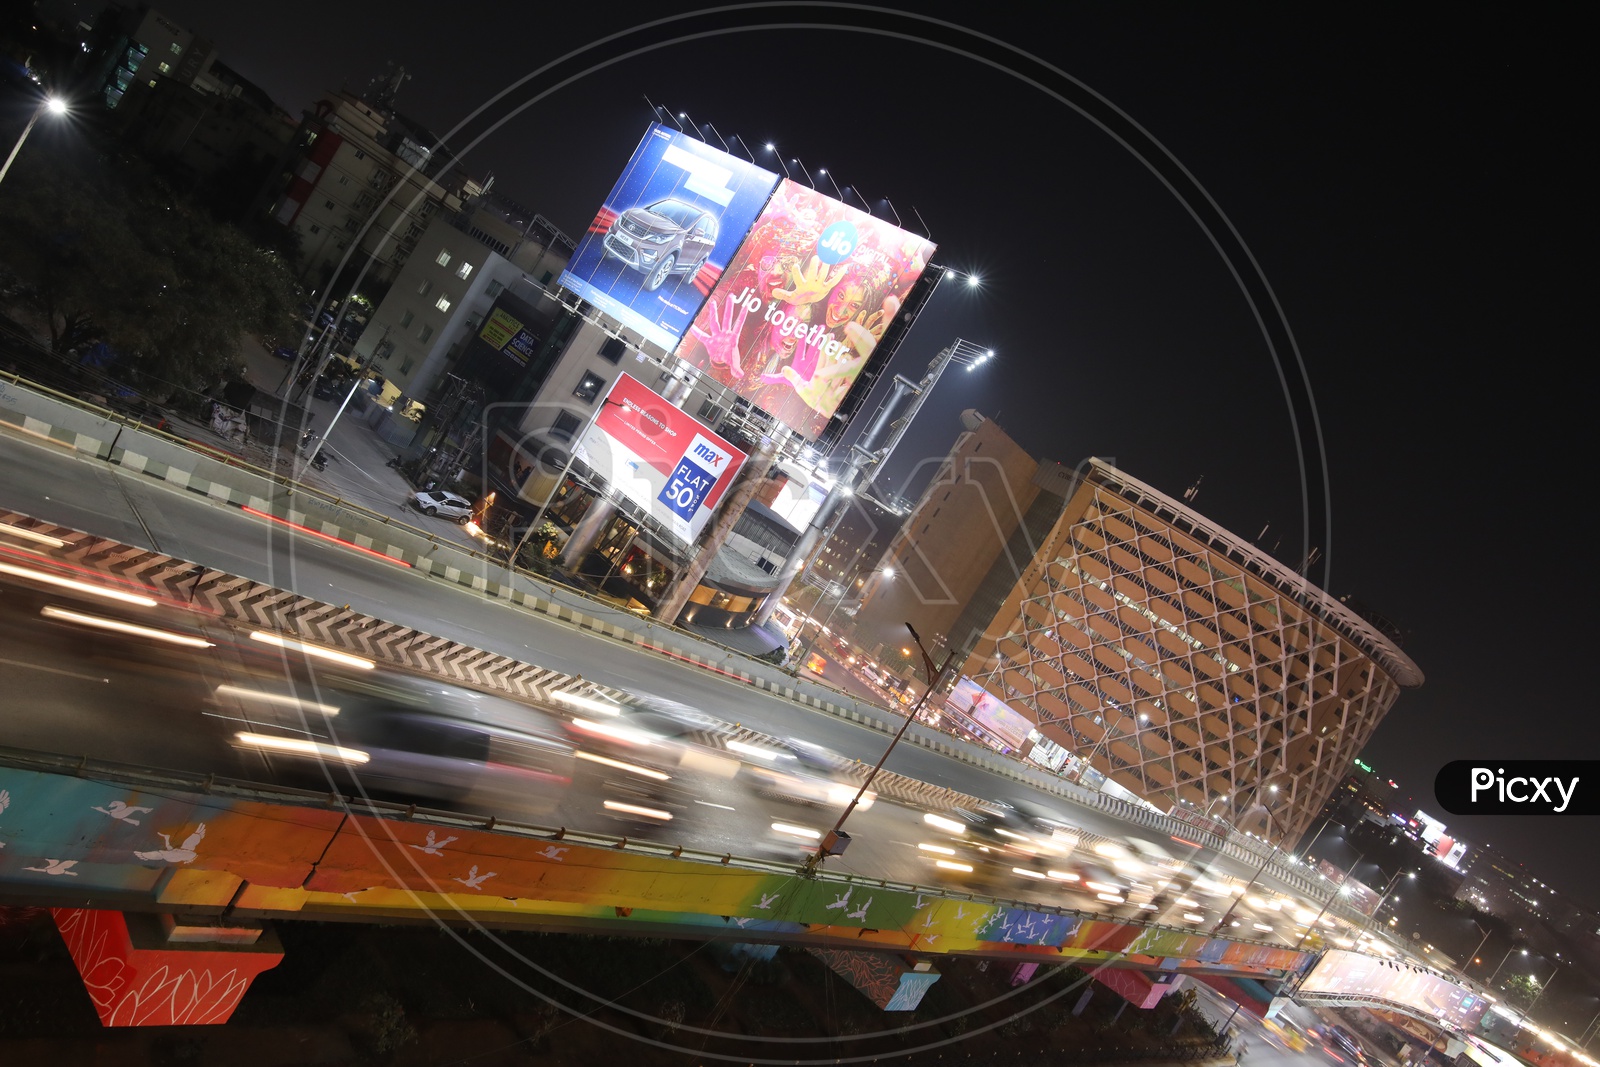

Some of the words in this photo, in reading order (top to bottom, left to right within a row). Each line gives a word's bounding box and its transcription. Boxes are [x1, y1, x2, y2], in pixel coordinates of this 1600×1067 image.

[821, 231, 852, 256] Jio
[857, 244, 890, 264] DIGITAL
[732, 286, 762, 313] Jio
[764, 301, 851, 364] together.
[511, 338, 534, 357] SCIENCE
[520, 332, 534, 346] DATA
[622, 397, 641, 412] ENDLESS
[640, 409, 659, 426] REASONS
[658, 421, 666, 430] TO
[665, 426, 677, 437] SHOP
[693, 443, 723, 467] max
[677, 464, 709, 491] FLAT
[665, 478, 694, 508] 50
